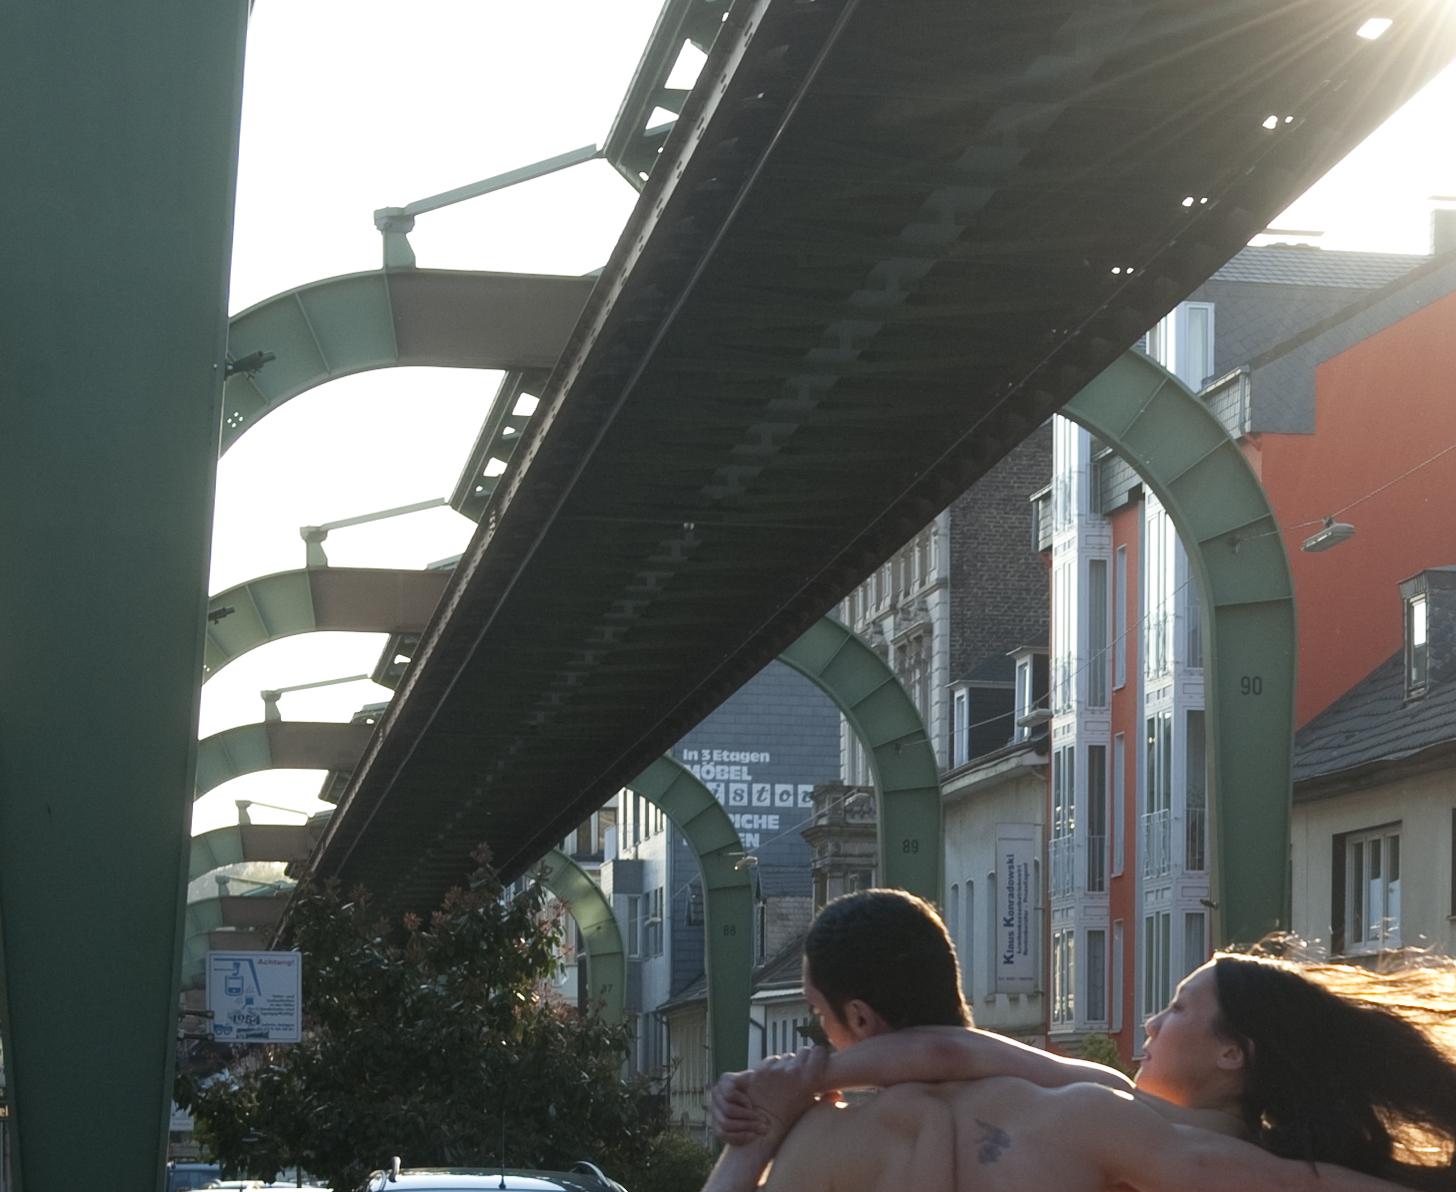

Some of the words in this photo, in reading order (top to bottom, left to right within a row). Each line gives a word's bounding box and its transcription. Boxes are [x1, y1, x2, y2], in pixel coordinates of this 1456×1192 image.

[1240, 675, 1263, 696] 90
[683, 749, 699, 761] In
[701, 749, 711, 761] 3
[713, 749, 770, 763] Etagen
[728, 814, 779, 829] ICHE
[902, 839, 919, 855] 89
[1003, 854, 1014, 927] Konradowski
[1003, 931, 1014, 965] Klaus
